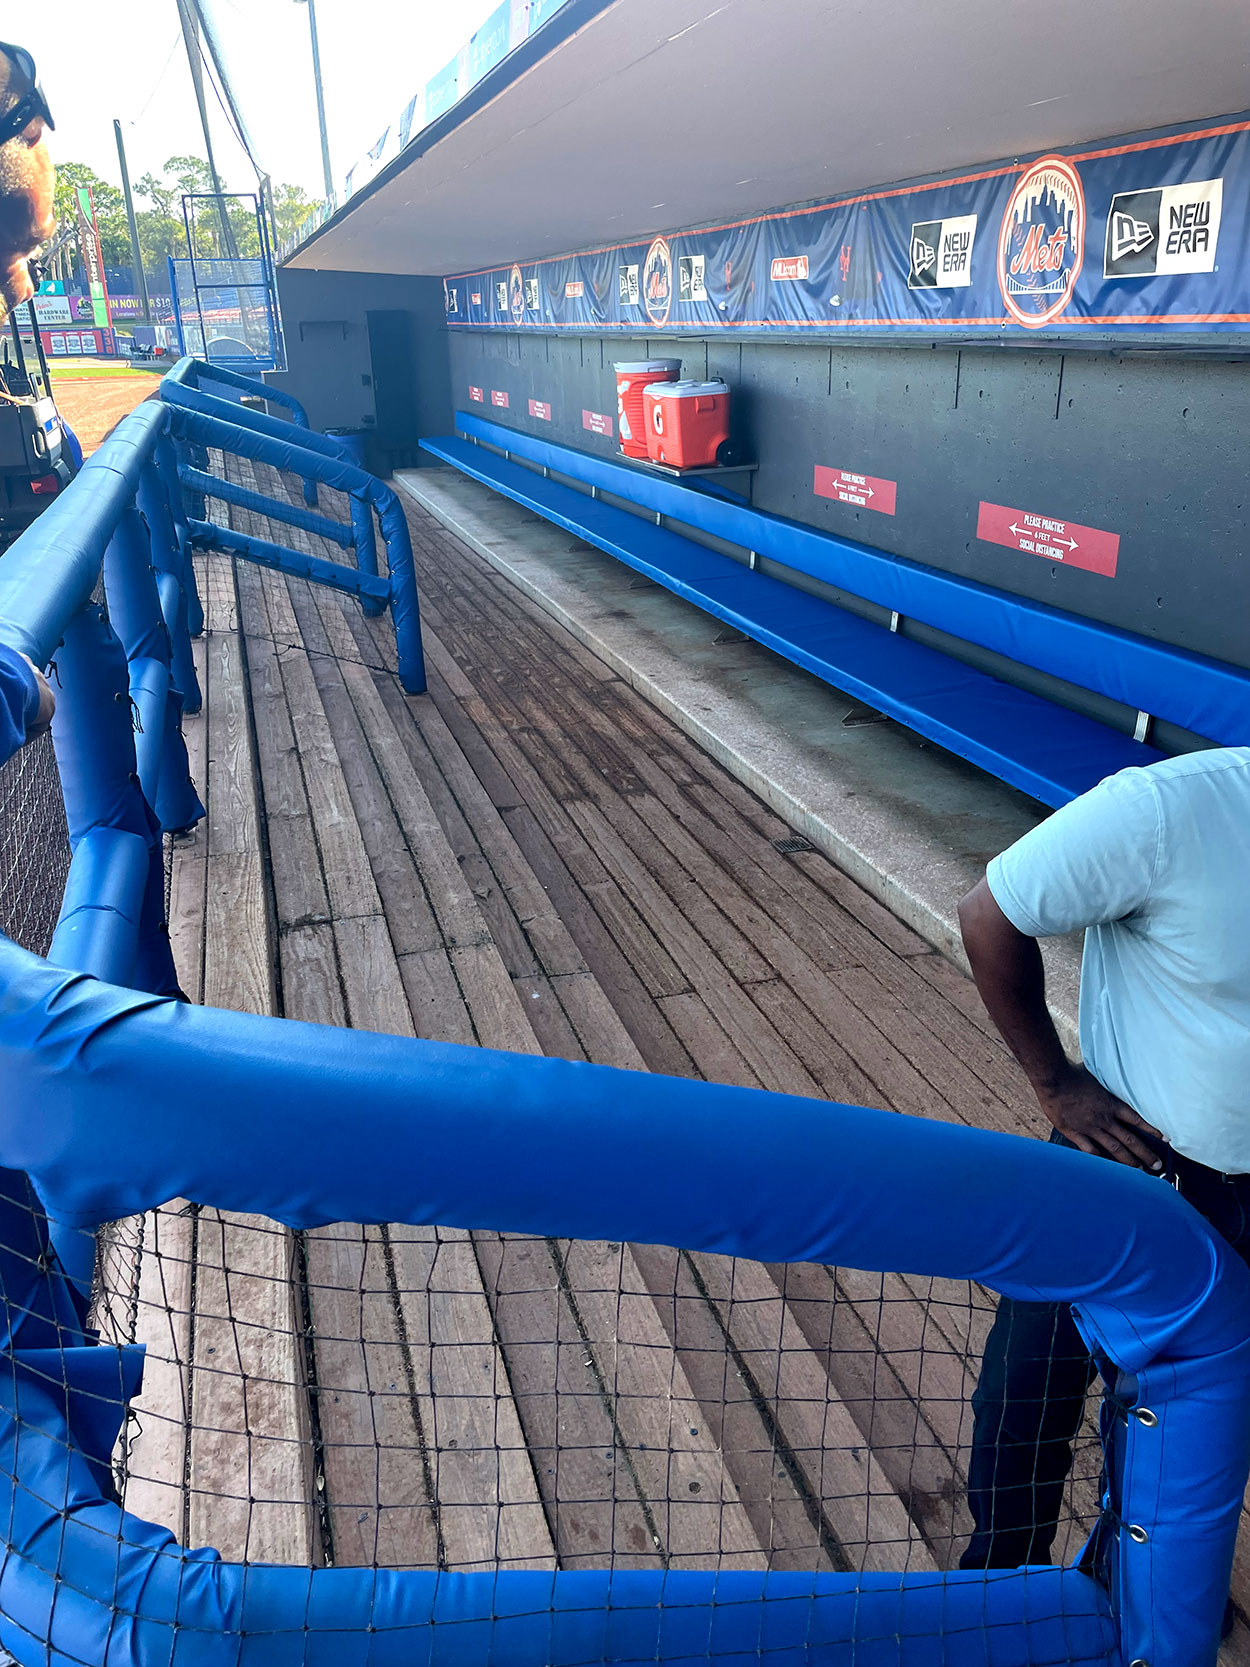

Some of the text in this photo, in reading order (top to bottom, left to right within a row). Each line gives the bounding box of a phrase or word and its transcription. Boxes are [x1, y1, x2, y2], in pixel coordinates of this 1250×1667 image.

[1169, 201, 1211, 230] NEW
[943, 231, 971, 254] NEW
[1011, 223, 1068, 275] Mets
[1165, 227, 1209, 255] ERA
[942, 252, 967, 273] ERA
[653, 404, 664, 435] G
[1023, 514, 1066, 535] PLEASE PRACTICE
[1038, 532, 1051, 542] FEET
[1019, 538, 1064, 560] SOCIAL DISTANCING
